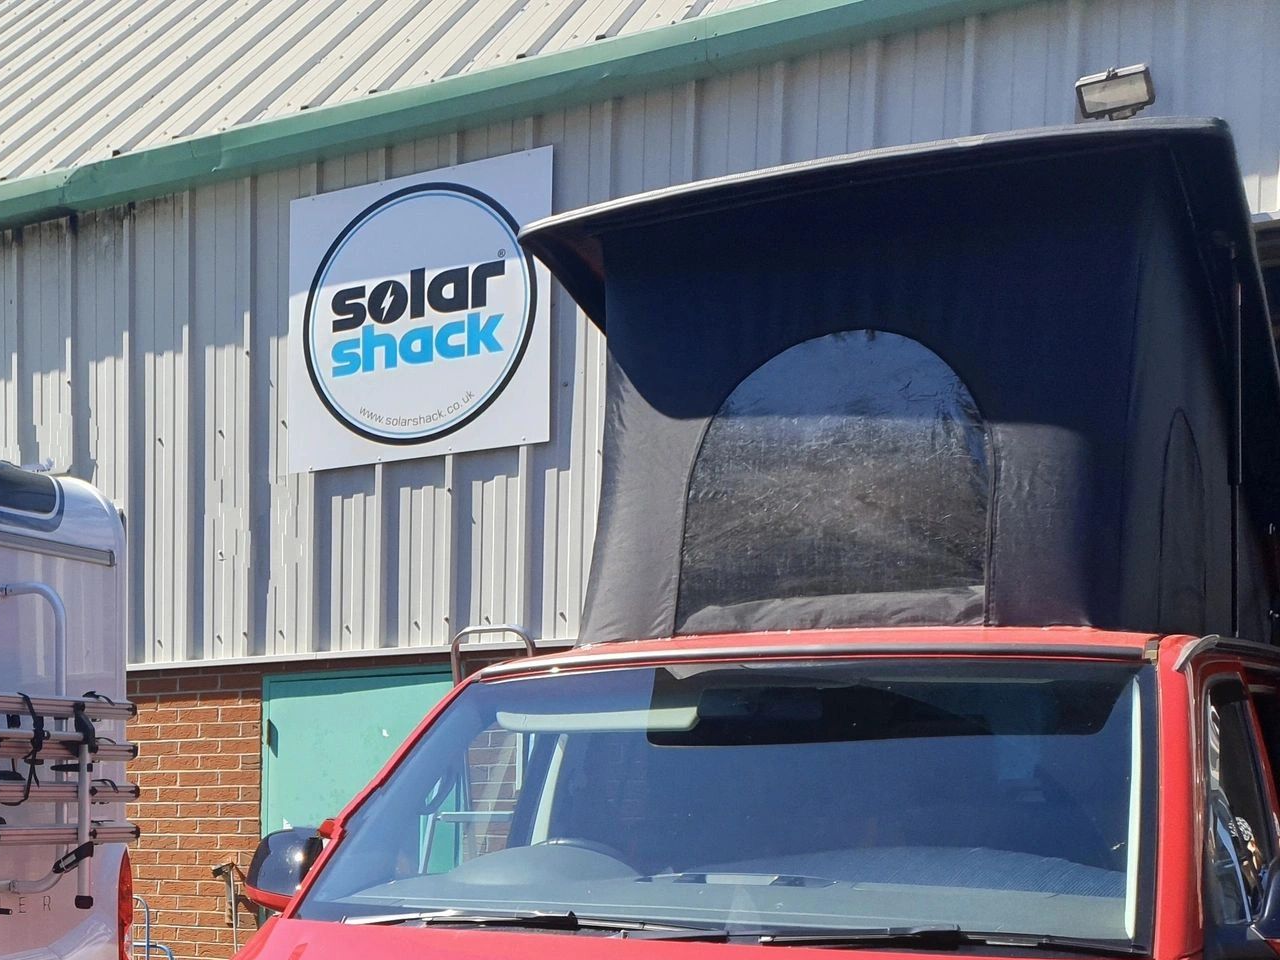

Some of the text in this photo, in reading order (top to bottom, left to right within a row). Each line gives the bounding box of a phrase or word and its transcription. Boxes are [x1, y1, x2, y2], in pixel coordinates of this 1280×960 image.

[331, 260, 505, 333] solar
[331, 313, 504, 378] shack
[359, 390, 475, 427] www.solarshack.co.uk
